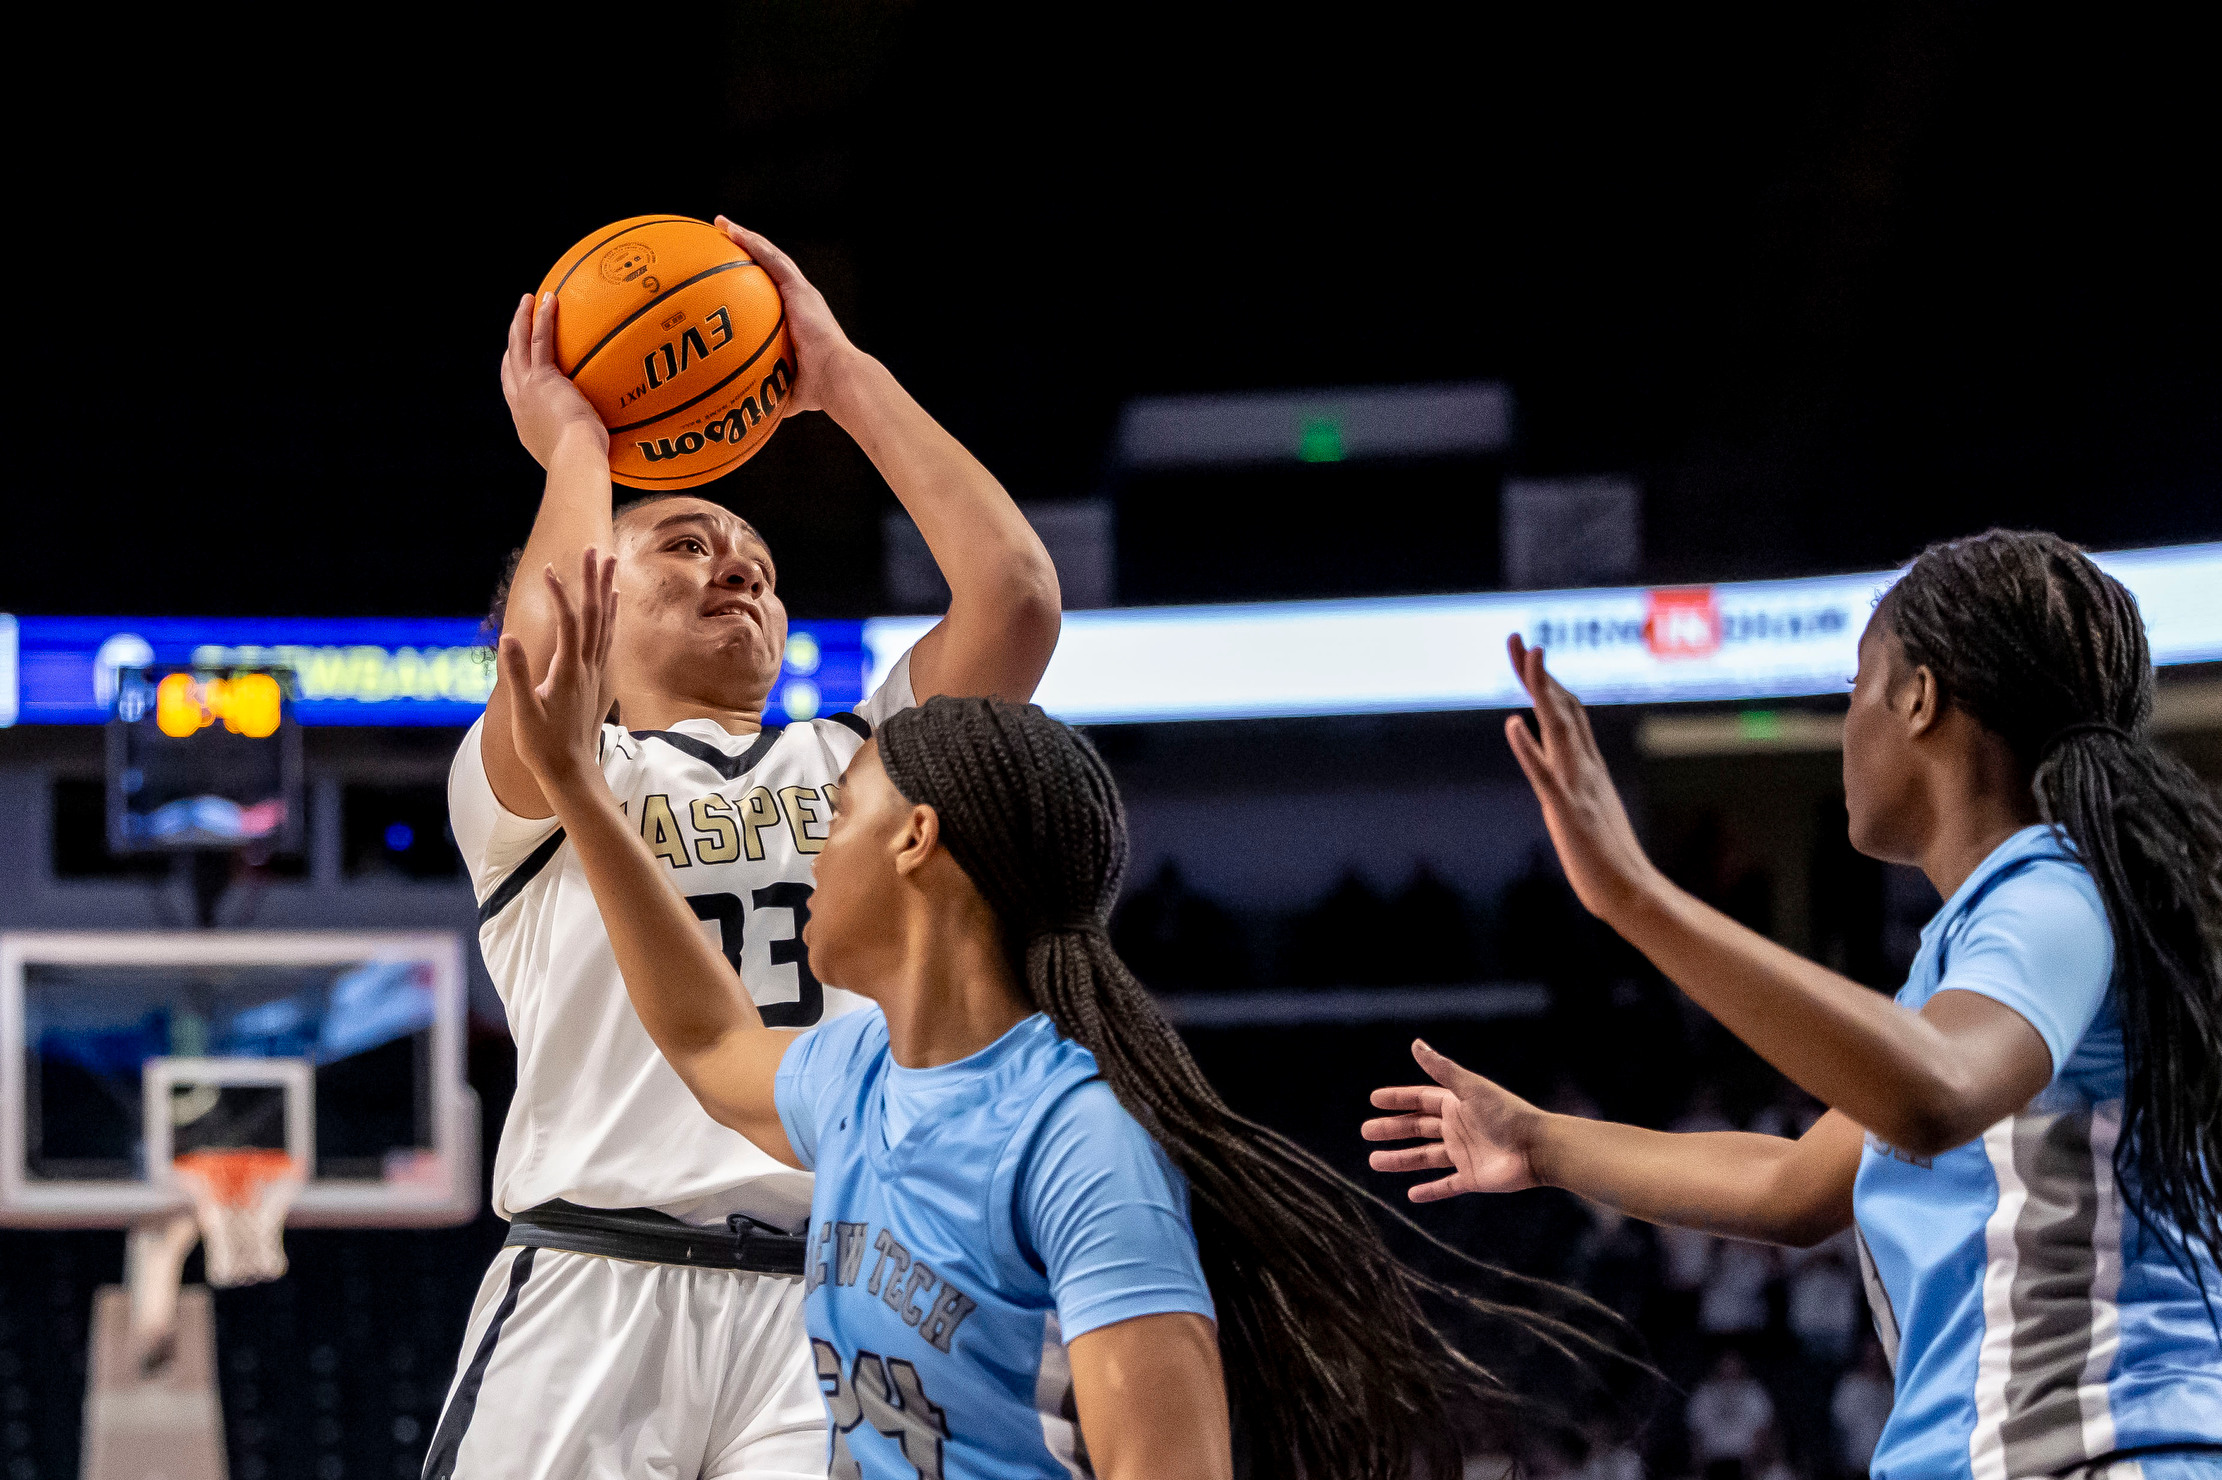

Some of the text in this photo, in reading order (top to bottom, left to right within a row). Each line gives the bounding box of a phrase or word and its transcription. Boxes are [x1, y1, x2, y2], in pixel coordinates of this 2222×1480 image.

[618, 383, 647, 409] NXT
[636, 356, 794, 462] Wilson
[619, 783, 838, 869] ASPE
[867, 1228, 978, 1354] TECH
